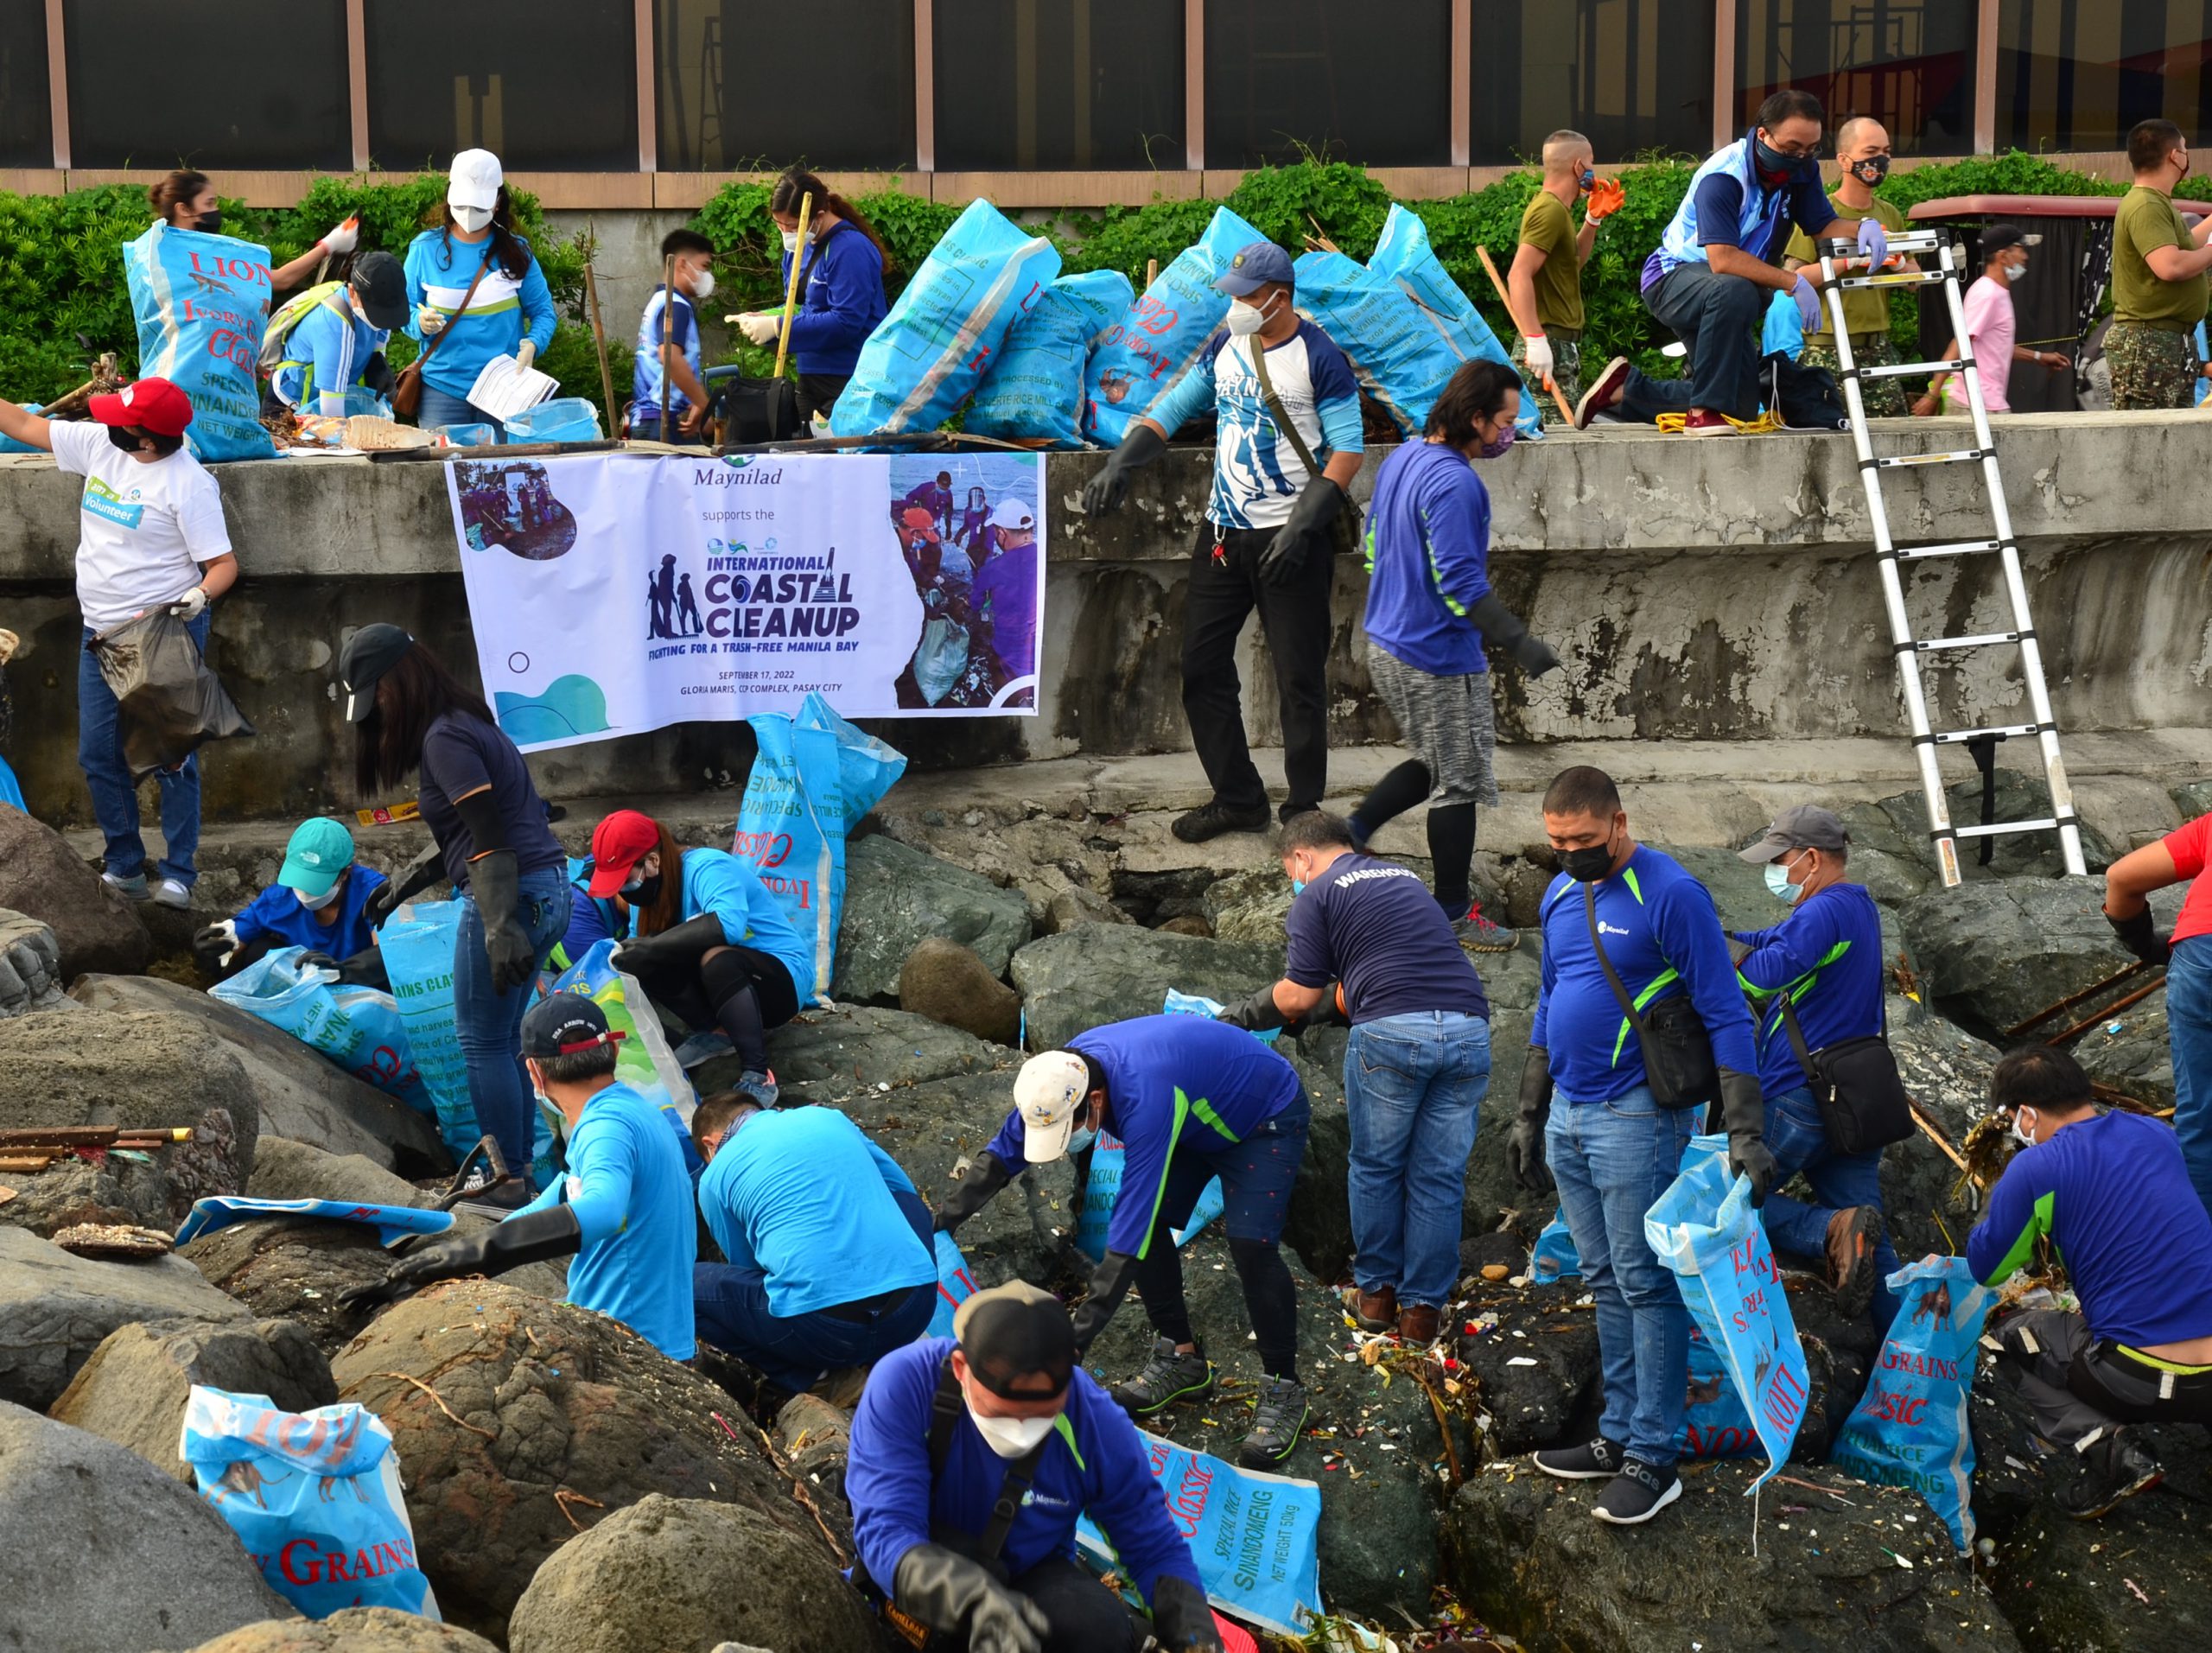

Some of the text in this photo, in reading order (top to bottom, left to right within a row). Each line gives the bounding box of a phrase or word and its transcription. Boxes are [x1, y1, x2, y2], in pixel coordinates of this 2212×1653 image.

[188, 251, 272, 286] LION
[1132, 295, 1179, 335] Clas
[208, 328, 255, 375] Clas
[694, 467, 783, 489] Maynilad
[86, 494, 134, 522] Volunteer
[702, 508, 775, 523] supports the
[707, 556, 825, 571] INTERNATIONAL
[704, 571, 853, 604] COASTAL
[706, 607, 861, 639] CLEANUP
[648, 641, 860, 661] FIGHTING FOR A TRASH-FREE MANILA BAY
[681, 683, 842, 696] GLORIA MARIS, CCP COMPLEX, PASAY CITY
[719, 671, 795, 681] SEPTEMBER 17, 2022
[764, 798, 803, 818] SPECIA
[734, 830, 793, 868] Classi
[760, 876, 810, 909] IVOR
[1334, 868, 1421, 888] WAREHOUS
[394, 972, 454, 999] AINS CLAS
[422, 1018, 454, 1033] harves
[433, 1037, 442, 1048] of
[1881, 1339, 1959, 1381] GRAINS
[1764, 1362, 1806, 1445] LION
[1590, 1438, 1614, 1469] das
[1681, 1425, 1758, 1457] ION
[1840, 1427, 1892, 1455] PECIAL
[1620, 1461, 1661, 1491] idas
[1214, 1486, 1243, 1561] SPECIAL RICE
[1234, 1490, 1274, 1592] SINANDOMENG
[1271, 1504, 1300, 1583] NET WEIGHT 50kg
[280, 1538, 415, 1586] GRAINS
